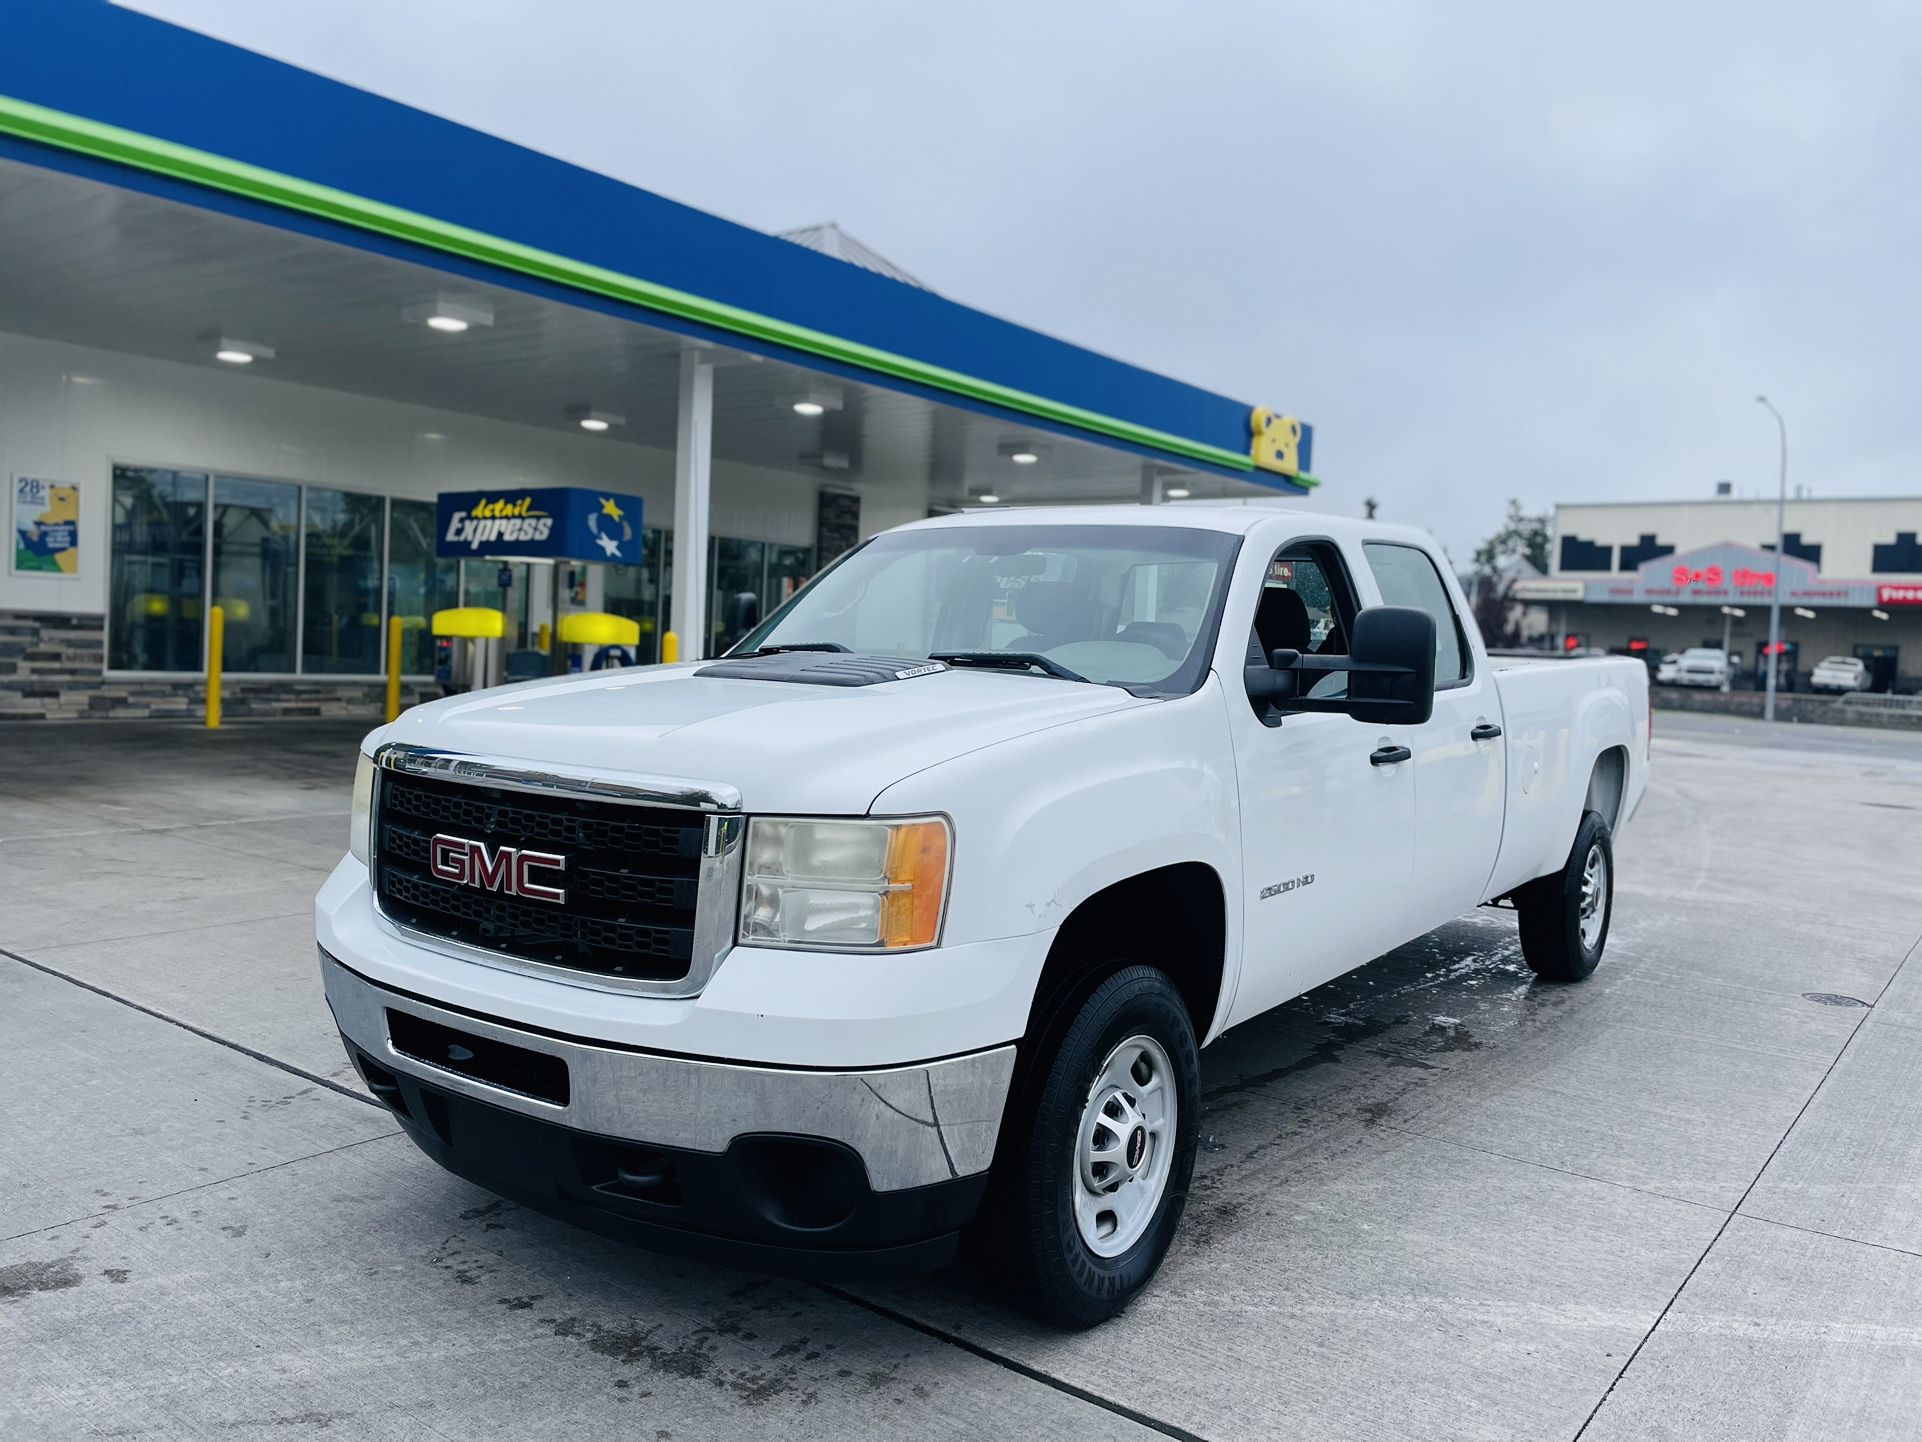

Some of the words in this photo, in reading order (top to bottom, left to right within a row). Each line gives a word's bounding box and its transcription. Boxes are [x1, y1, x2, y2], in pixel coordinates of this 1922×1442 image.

[471, 496, 549, 518] detail
[445, 511, 553, 550] Express
[903, 665, 937, 677] VORTEC
[431, 833, 565, 904] GMC
[1260, 880, 1295, 900] 2500
[1297, 874, 1315, 888] HD
[1132, 1129, 1142, 1166] GMC
